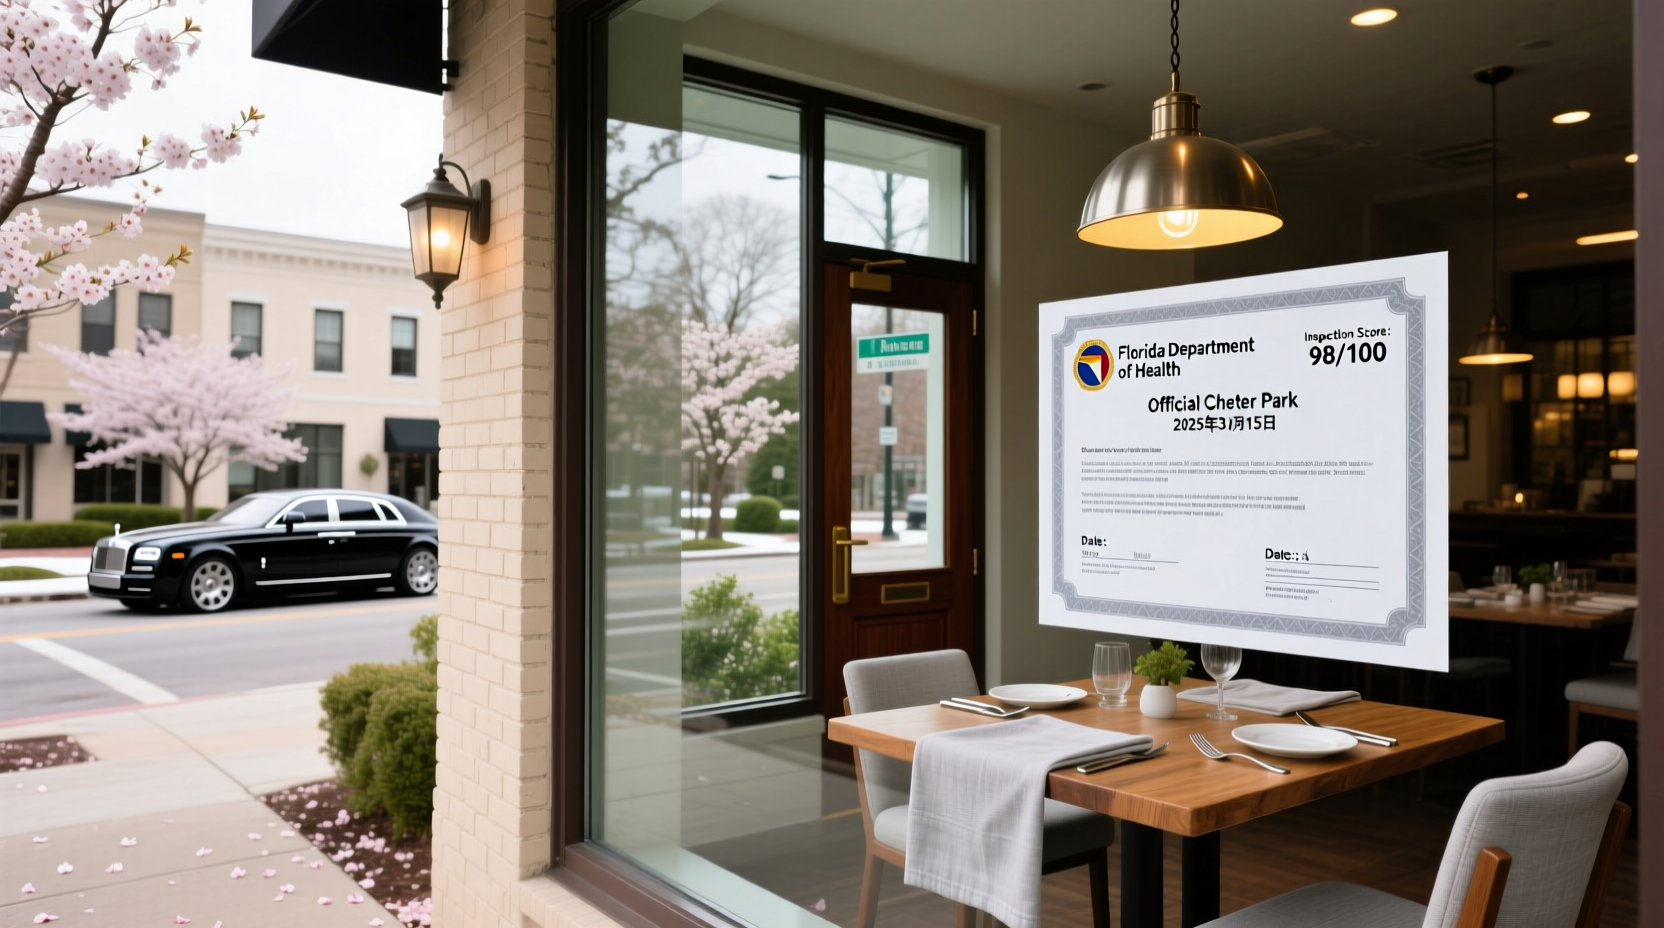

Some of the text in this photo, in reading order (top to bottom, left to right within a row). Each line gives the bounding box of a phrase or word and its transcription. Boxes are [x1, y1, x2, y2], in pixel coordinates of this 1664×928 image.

[1357, 326, 1391, 338] Score:
[1118, 336, 1256, 360] Florida Department
[1309, 341, 1387, 368] 98/100
[1118, 360, 1181, 379] of Health
[1148, 390, 1299, 413] Official Cheter Park
